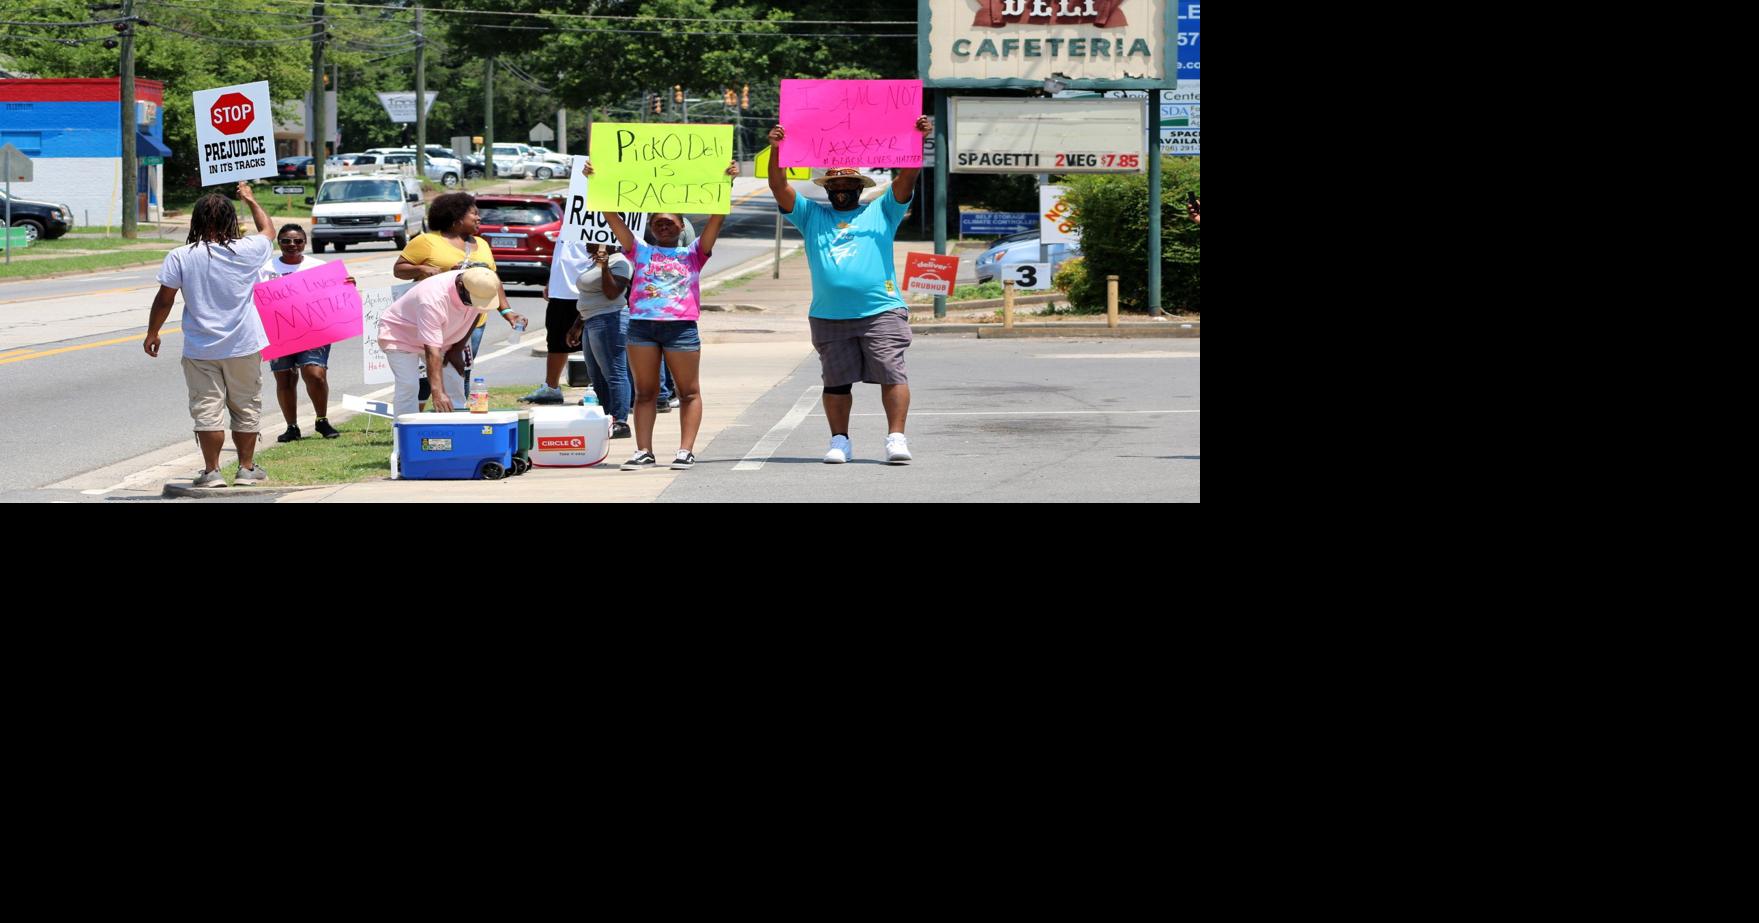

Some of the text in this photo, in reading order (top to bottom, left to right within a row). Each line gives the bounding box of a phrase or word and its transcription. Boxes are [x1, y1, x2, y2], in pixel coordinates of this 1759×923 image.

[952, 38, 1151, 57] CAFETERIA
[829, 89, 878, 113] AM
[884, 84, 921, 115] NOT
[1163, 91, 1200, 101] Cente
[213, 103, 252, 125] STOP
[204, 135, 266, 162] PREJUDICE
[687, 133, 724, 161] Deli
[209, 157, 266, 174] IN ITS TRACKS
[958, 152, 1039, 167] SPAGETTI
[1100, 153, 1139, 168] $7.85
[617, 179, 730, 208] RACIST
[910, 281, 947, 291] GRUBHUB
[1015, 265, 1038, 287] 3
[255, 276, 338, 307] Black Lives
[274, 292, 354, 341] MATTER
